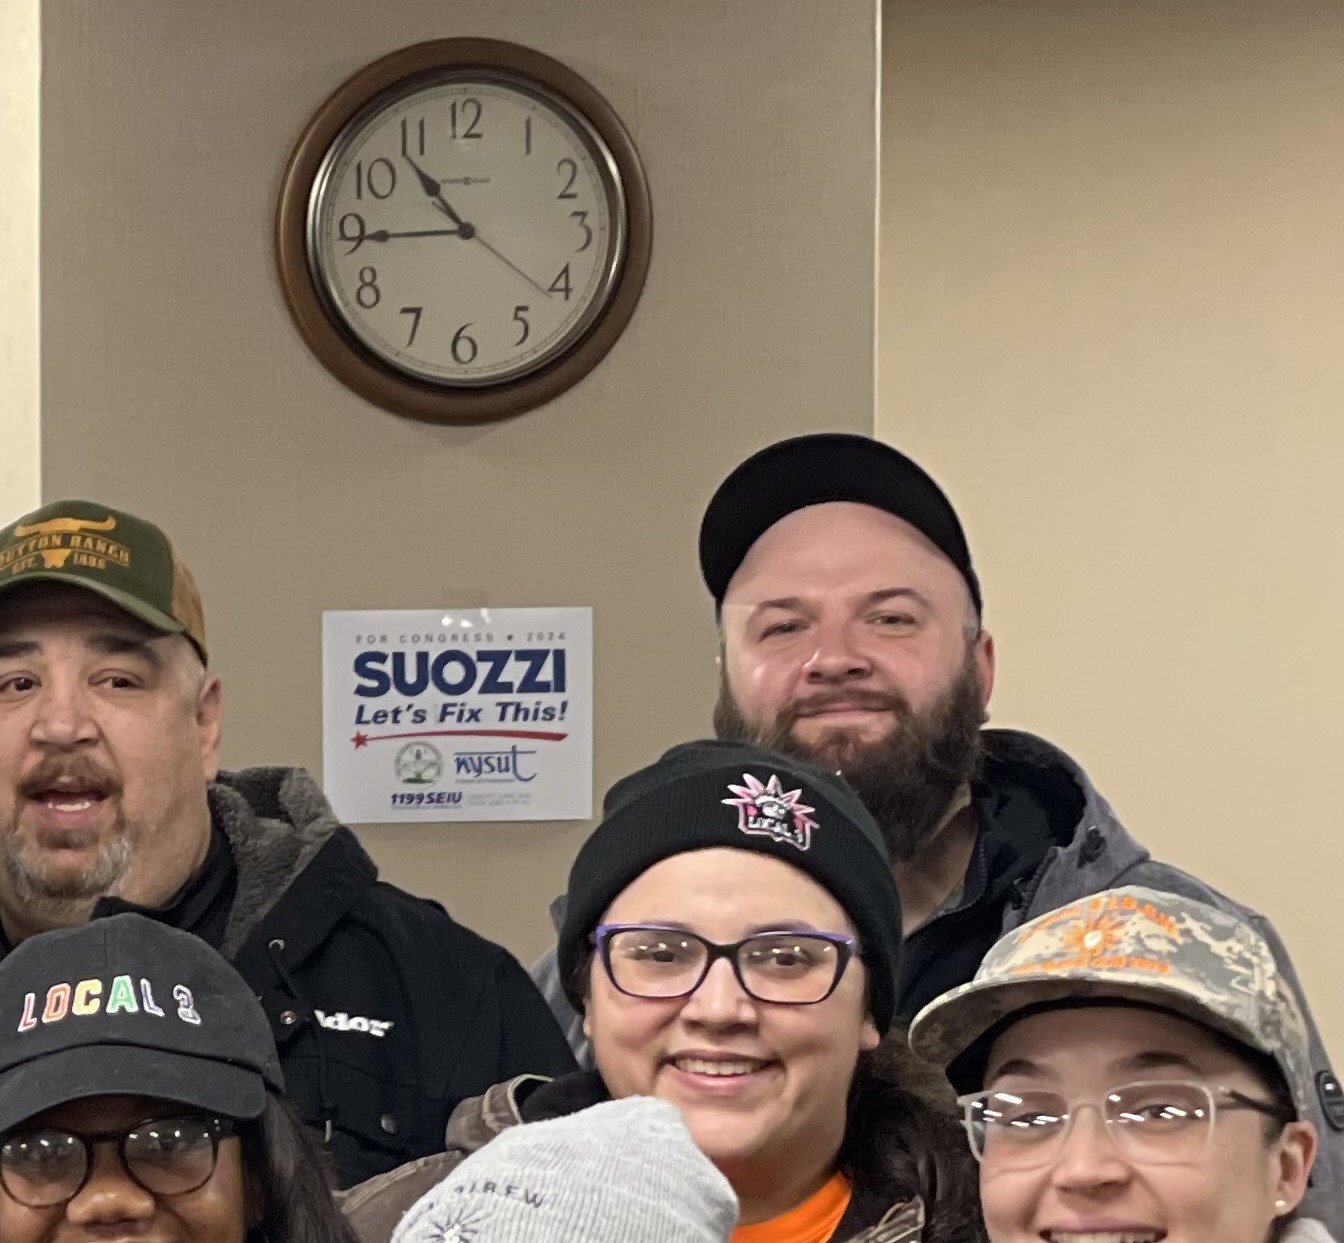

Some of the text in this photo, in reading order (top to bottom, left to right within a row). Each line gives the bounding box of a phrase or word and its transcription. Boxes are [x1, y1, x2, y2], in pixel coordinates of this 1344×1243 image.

[400, 117, 426, 156] 11
[449, 98, 483, 140] 12
[524, 116, 533, 156] 1
[354, 157, 397, 200] 10
[555, 157, 579, 199] 2
[338, 212, 367, 255] 9
[569, 210, 593, 253] 3
[354, 265, 381, 309] 8
[547, 262, 574, 301] 4
[399, 306, 424, 349] 7
[450, 321, 478, 365] 6
[512, 305, 531, 347] 5
[355, 634, 389, 645] FOR
[399, 632, 494, 644] CONGRESS
[353, 649, 567, 698] SUOZZI
[354, 700, 569, 726] Let's Fix This!
[390, 791, 463, 806] 1199SEIU
[17, 974, 202, 1033] LOCAL 3
